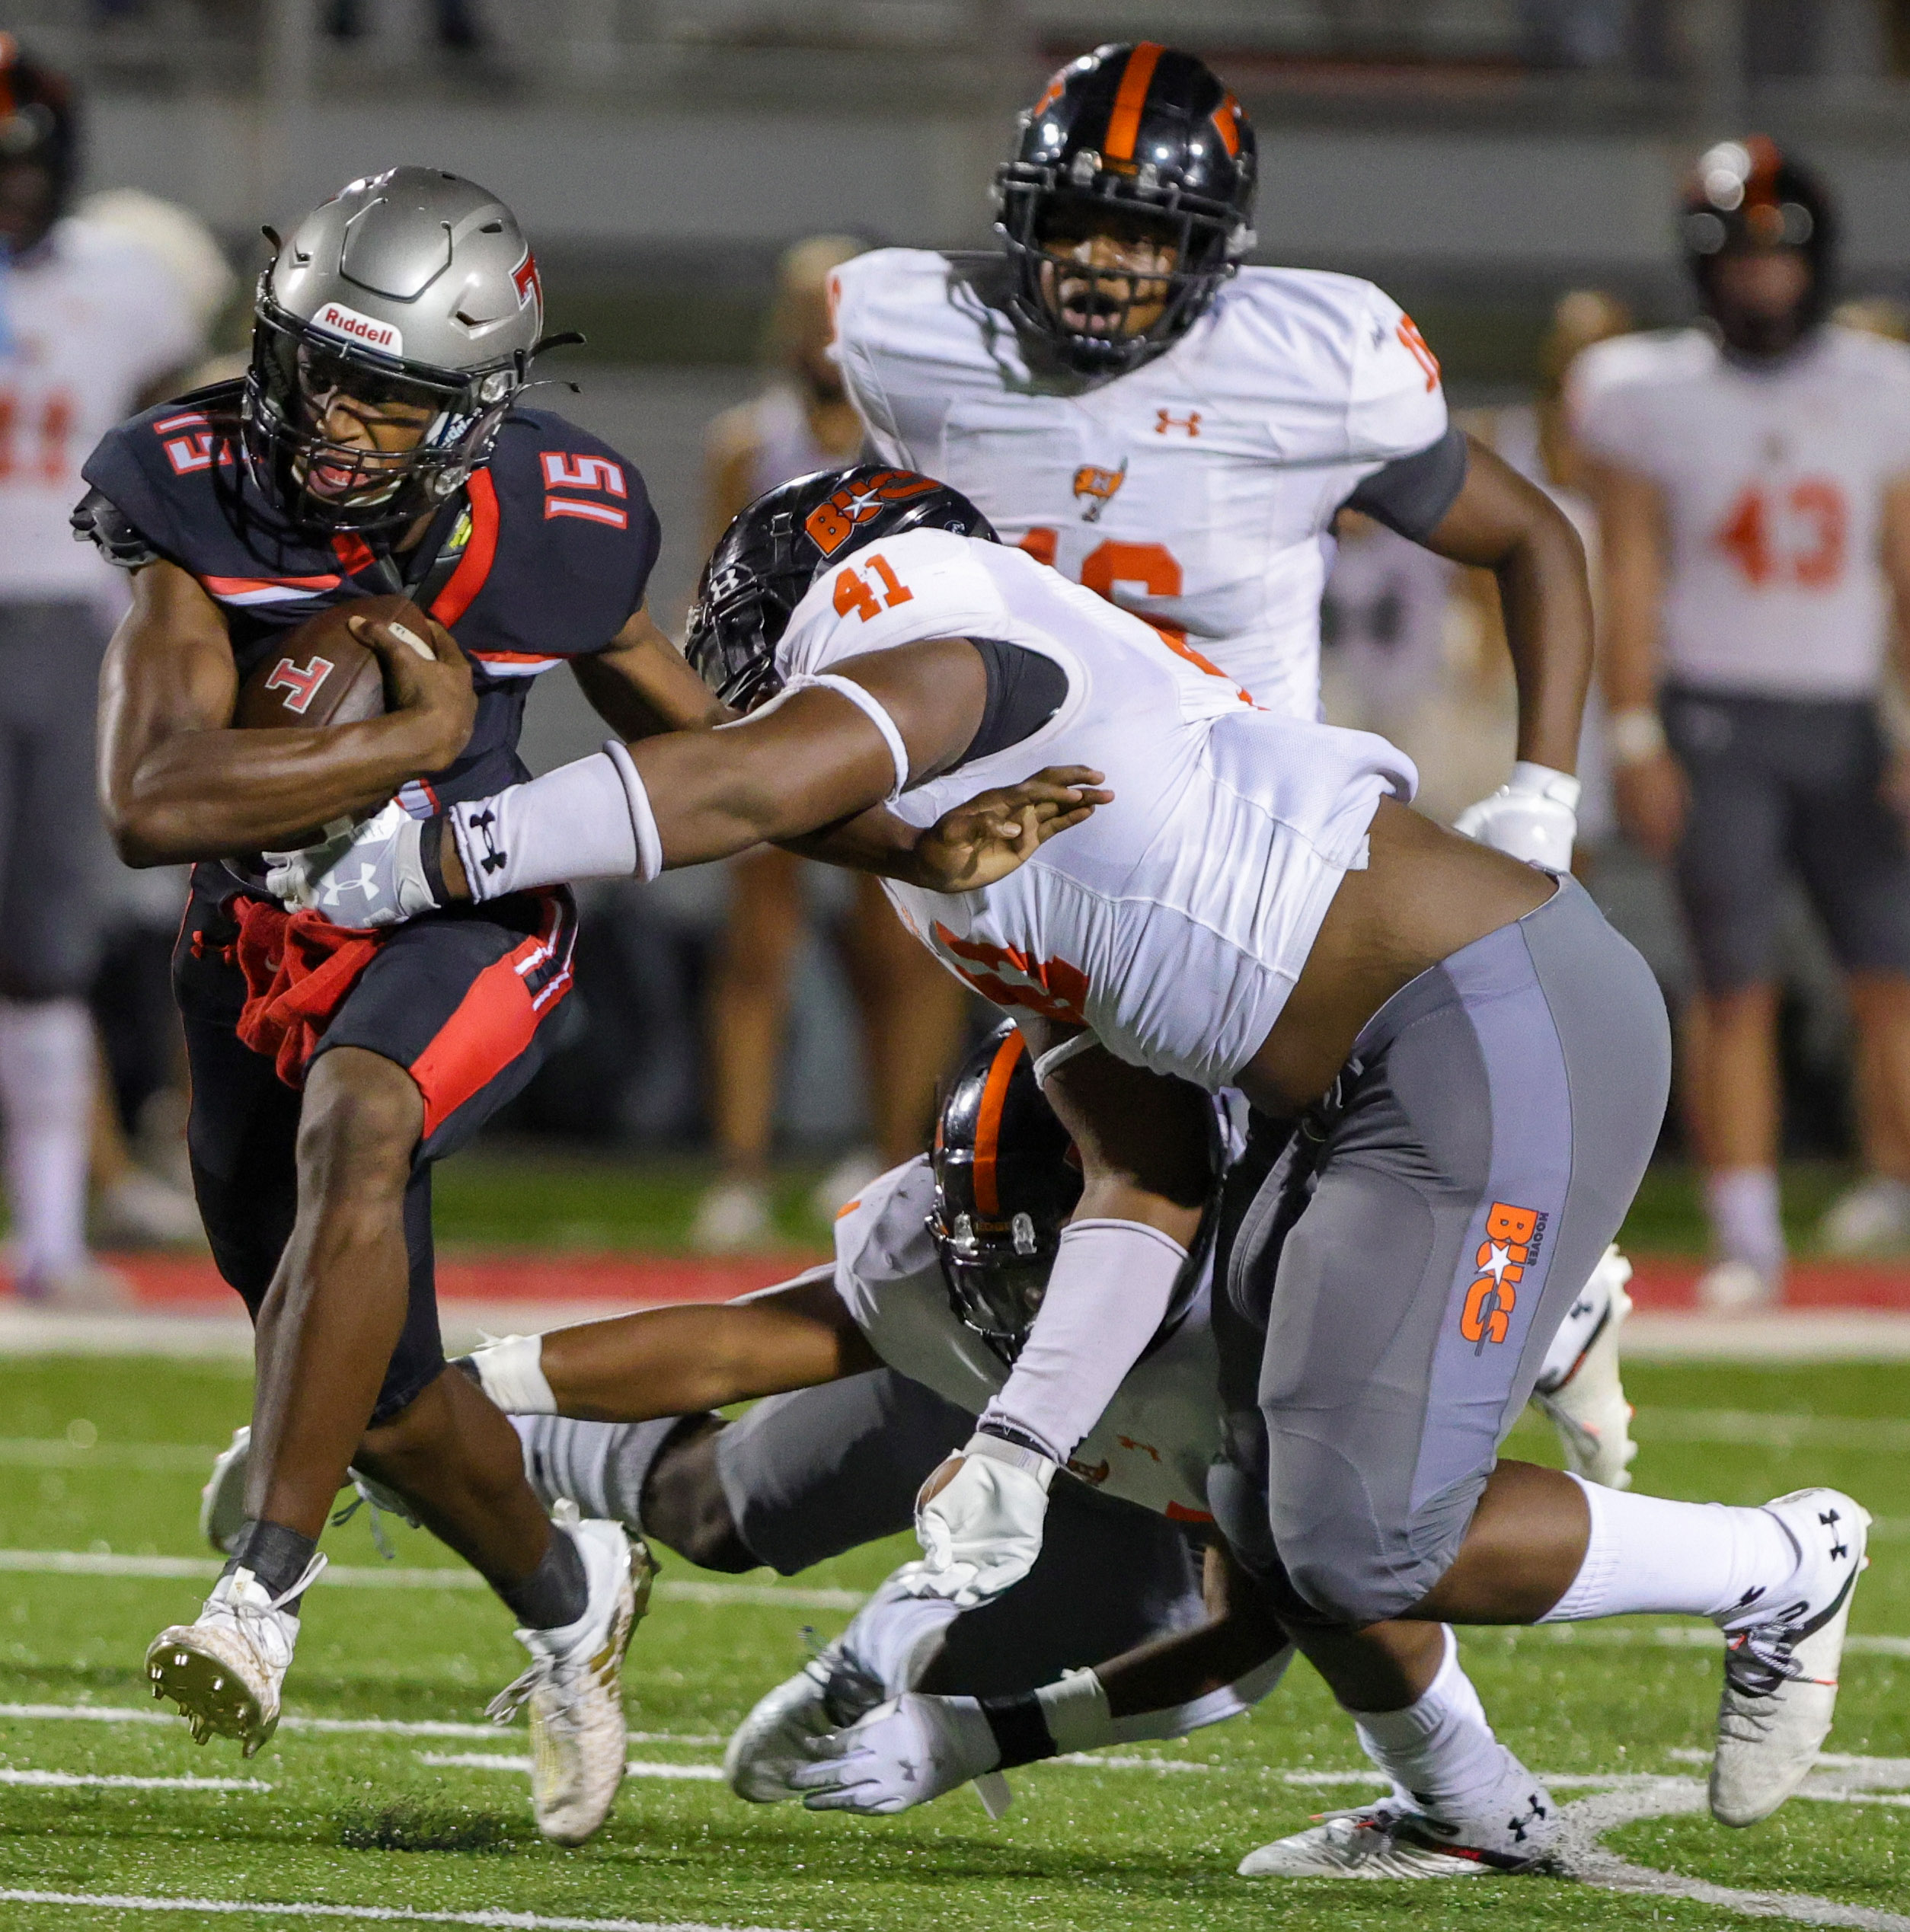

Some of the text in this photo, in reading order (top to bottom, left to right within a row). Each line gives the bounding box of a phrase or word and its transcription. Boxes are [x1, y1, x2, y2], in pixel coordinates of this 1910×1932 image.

[325, 308, 393, 345] Riddell
[539, 451, 628, 529] 15
[833, 554, 914, 622] 41
[265, 656, 335, 714] T
[1527, 1212, 1549, 1266] HOOVER
